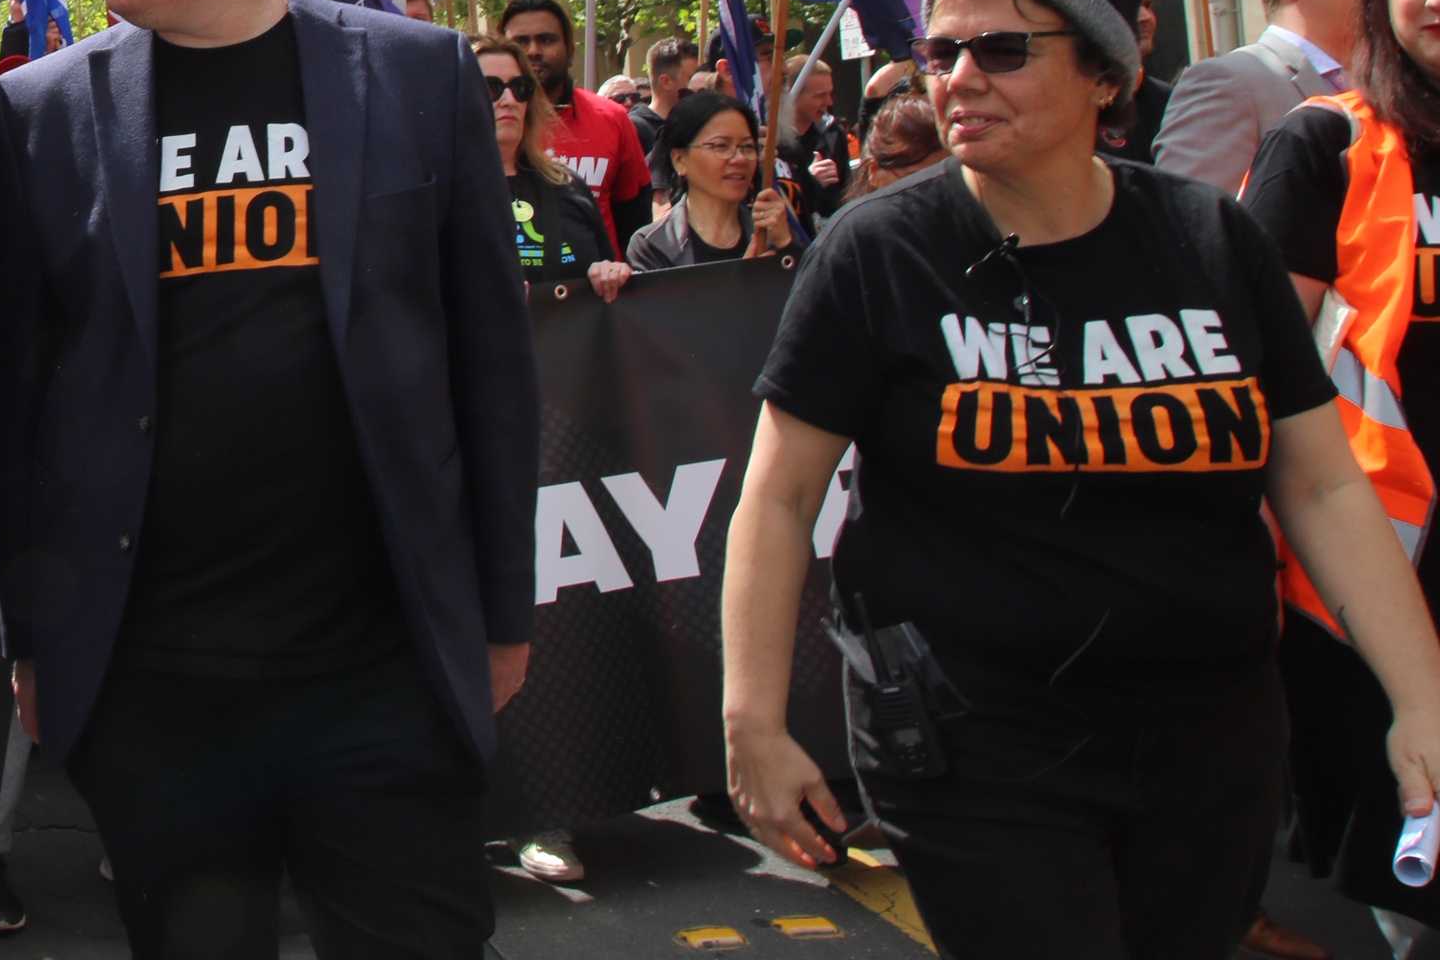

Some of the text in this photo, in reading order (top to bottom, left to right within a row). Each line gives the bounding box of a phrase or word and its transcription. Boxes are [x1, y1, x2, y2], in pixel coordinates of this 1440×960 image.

[160, 123, 311, 192] E AR
[160, 190, 313, 273] NIO
[940, 309, 1242, 386] WE ARE
[952, 387, 1263, 466] UNION
[534, 458, 727, 606] AY
